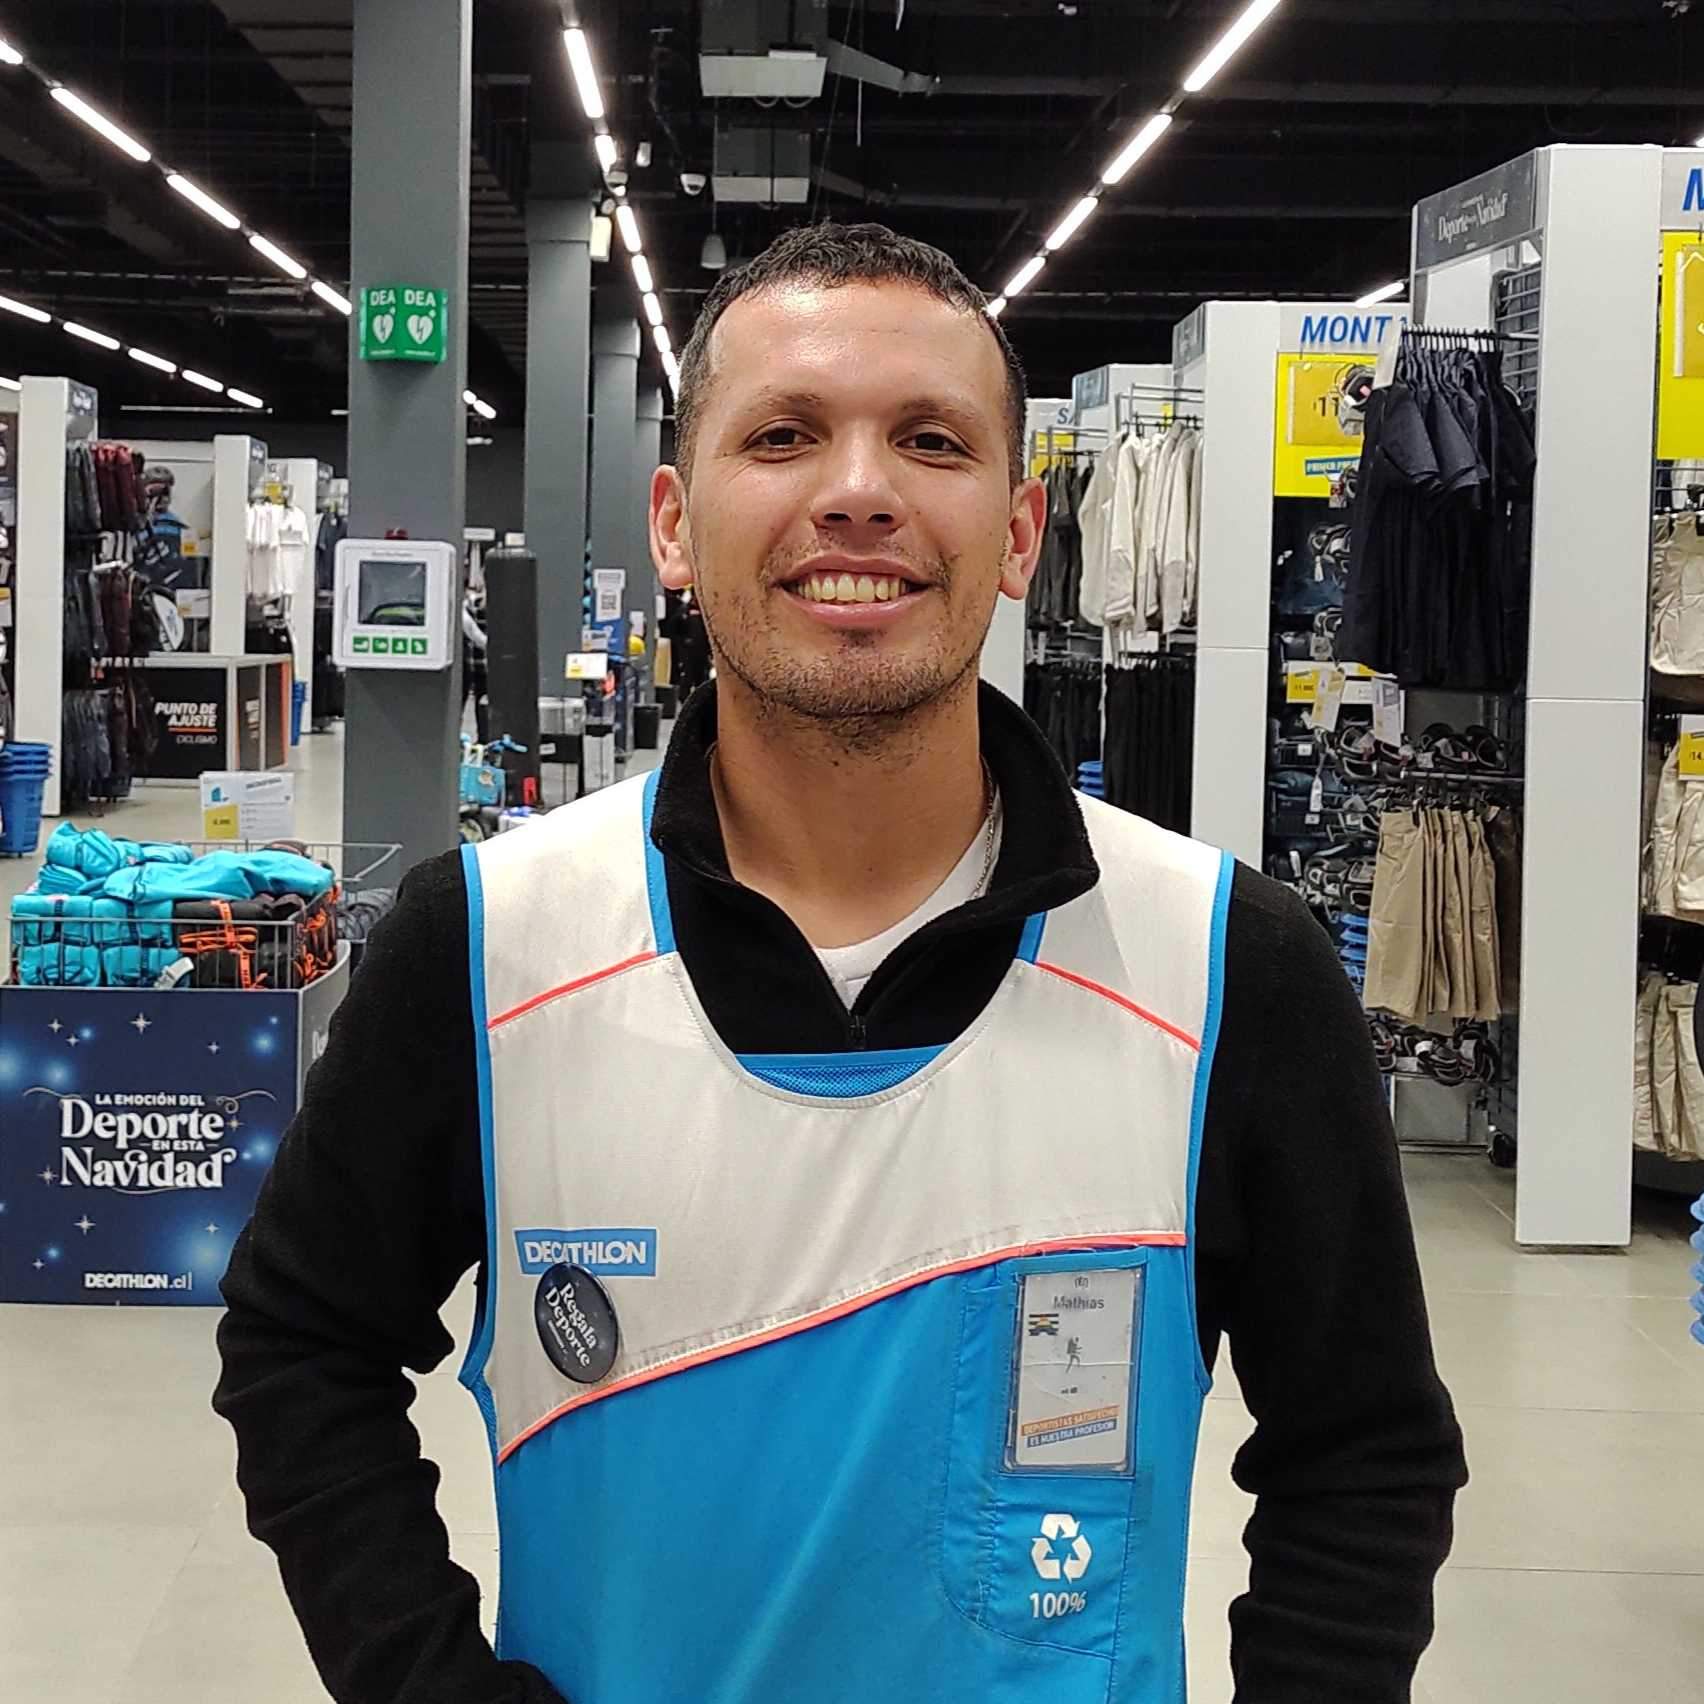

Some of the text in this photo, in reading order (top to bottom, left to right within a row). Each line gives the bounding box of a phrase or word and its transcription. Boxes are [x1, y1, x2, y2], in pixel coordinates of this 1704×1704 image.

[370, 289, 396, 306] DEA
[404, 289, 436, 307] DEA
[1300, 315, 1394, 344] MONT
[154, 702, 218, 714] PUNTO DE
[167, 714, 218, 727] AJUSTE
[95, 1092, 205, 1106] LA EMOCIÓN DEL
[61, 1098, 225, 1149] Deporte
[152, 1140, 205, 1151] EN ESTA
[60, 1147, 237, 1188] Navidad
[523, 1240, 648, 1265] DECATHLON
[1053, 1295, 1105, 1310] Mathias
[559, 1281, 598, 1350] Regala
[544, 1286, 592, 1367] Deporte
[1029, 1591, 1087, 1618] 100%
